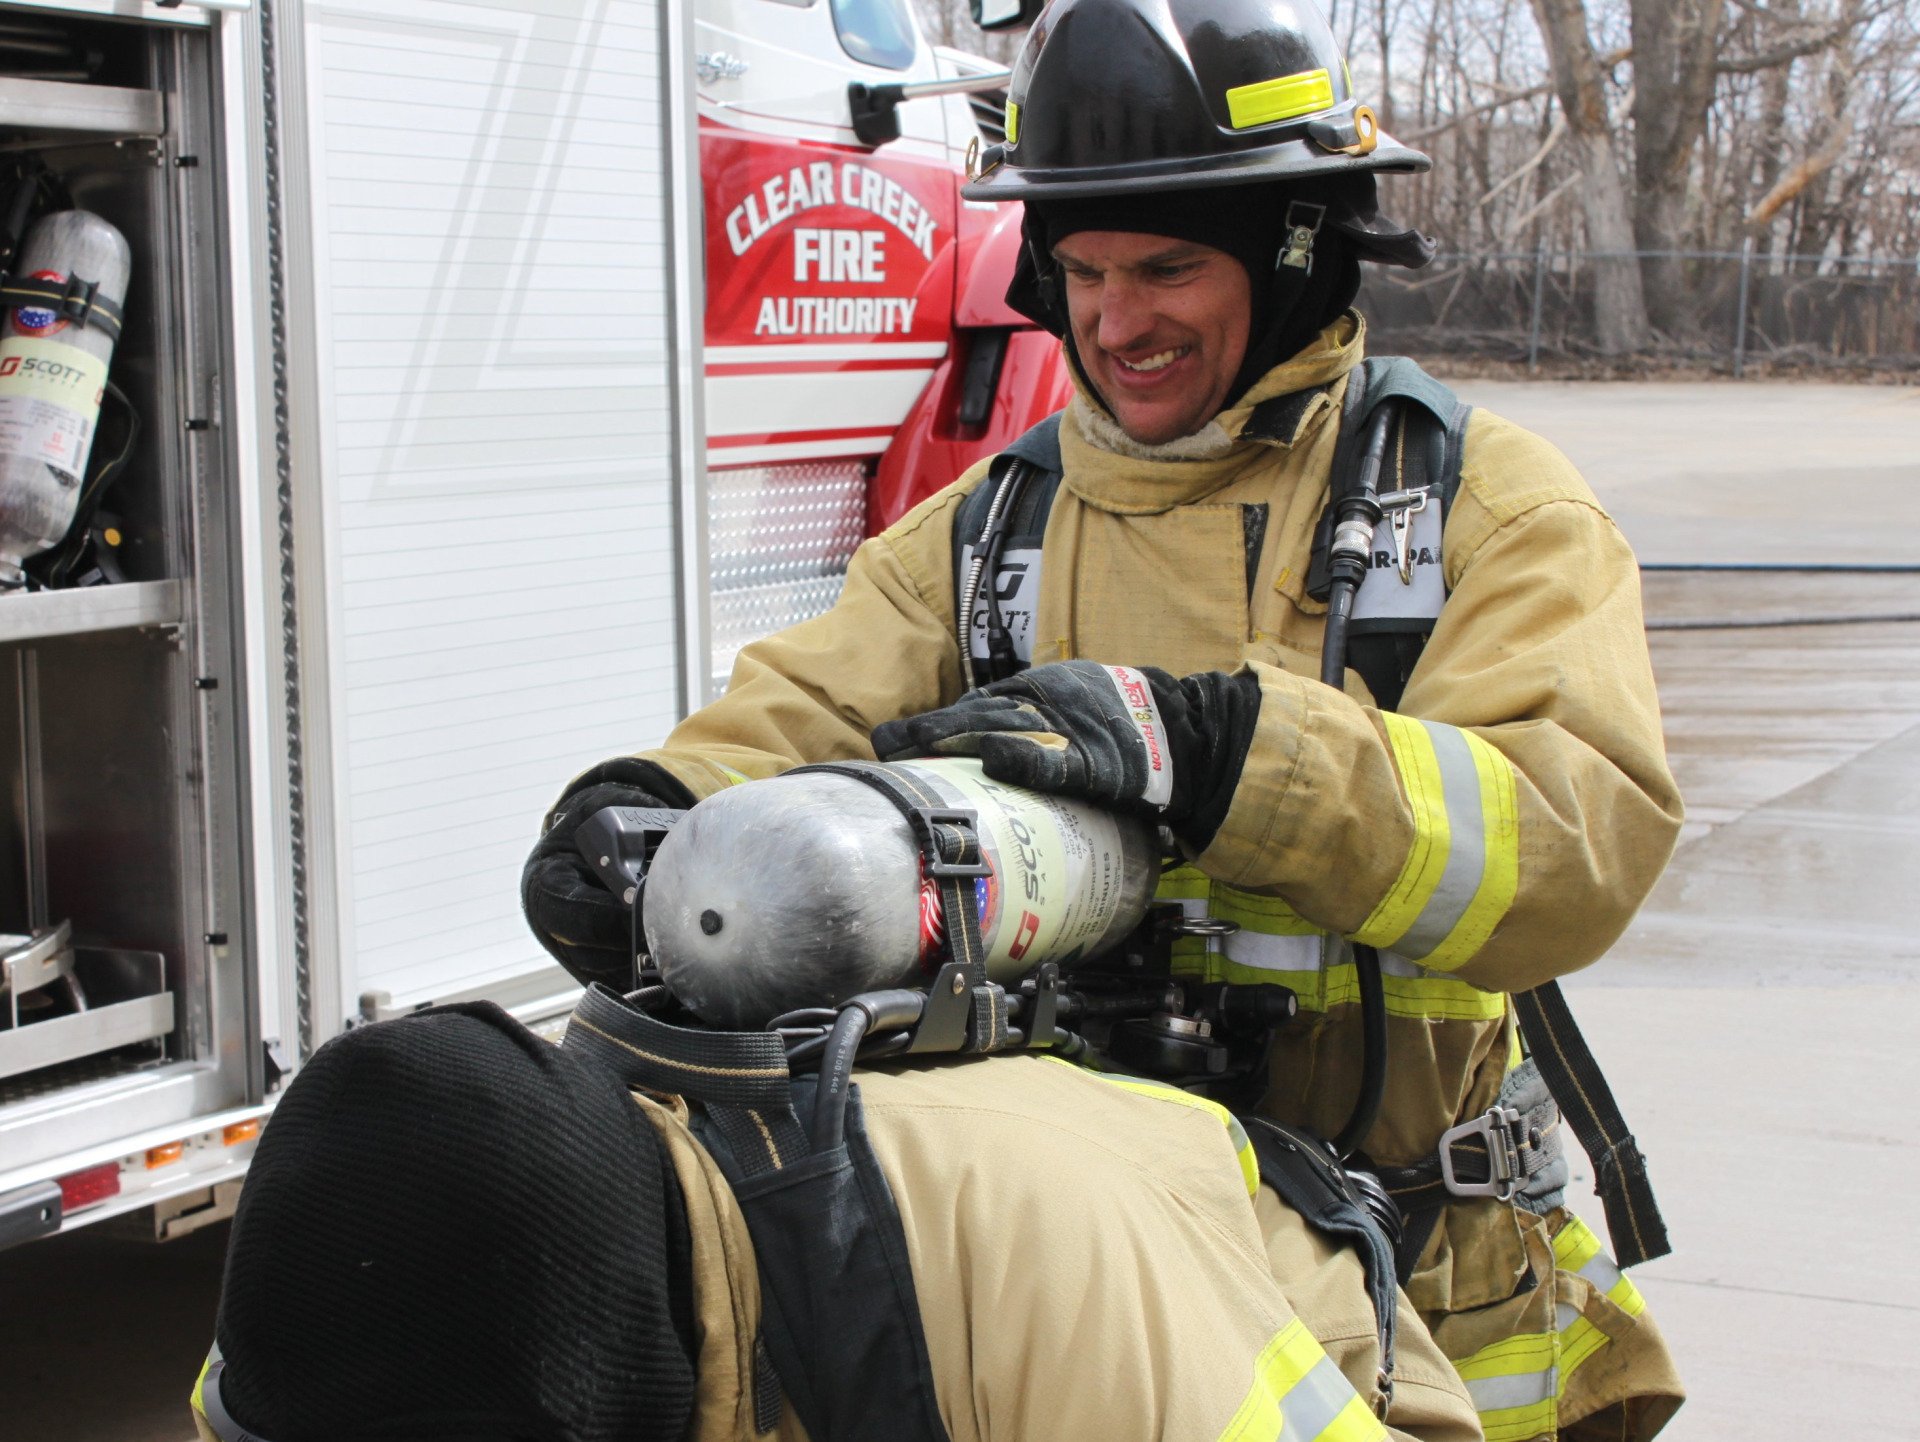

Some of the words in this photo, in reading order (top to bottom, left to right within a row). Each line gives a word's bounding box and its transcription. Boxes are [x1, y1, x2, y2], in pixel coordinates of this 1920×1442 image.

[725, 161, 836, 256] CLEAR
[840, 162, 938, 261] CREEK
[793, 227, 886, 282] FIRE
[754, 297, 918, 335] AUTHORITY
[23, 358, 86, 384] SCOTT
[1096, 852, 1111, 918] MINUTES
